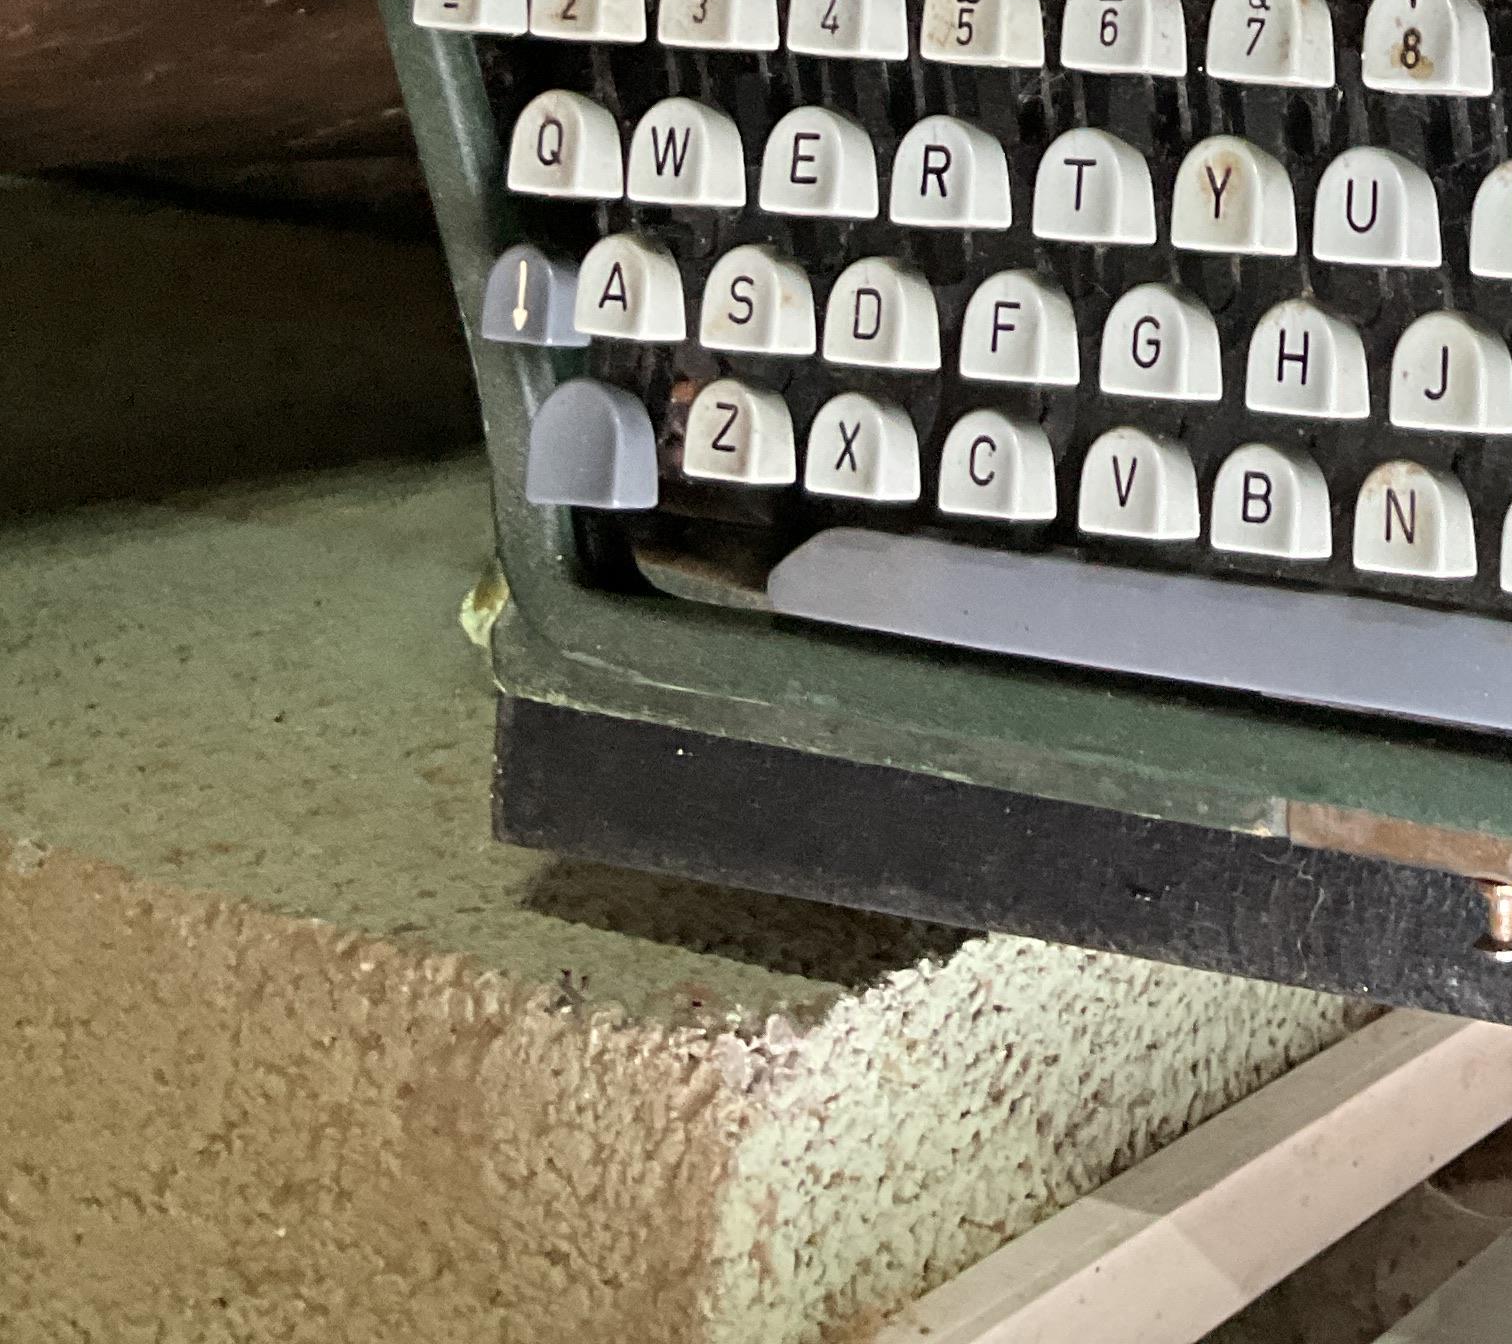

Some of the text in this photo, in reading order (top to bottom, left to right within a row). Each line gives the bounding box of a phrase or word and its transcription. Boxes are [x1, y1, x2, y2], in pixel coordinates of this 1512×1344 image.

[820, 0, 840, 35] 4
[956, 7, 975, 46] 5
[1099, 7, 1119, 47] 6
[1246, 17, 1266, 57] 7
[1399, 27, 1425, 70] 8
[536, 115, 564, 167] Q
[651, 126, 691, 178] W
[789, 132, 821, 185] E
[920, 144, 952, 198] R
[1063, 158, 1097, 212] T
[1205, 166, 1232, 220] Y
[1346, 179, 1378, 234] U
[598, 261, 628, 312] A
[727, 275, 755, 325] S
[852, 287, 882, 341] D
[991, 301, 1021, 353] F
[1132, 315, 1161, 369] G
[1277, 329, 1309, 386] H
[1424, 345, 1449, 401] J
[711, 402, 739, 453] Z
[835, 421, 861, 473] X
[969, 435, 997, 487] C
[1112, 455, 1138, 508] V
[1241, 471, 1272, 524] B
[1385, 488, 1416, 545] N
